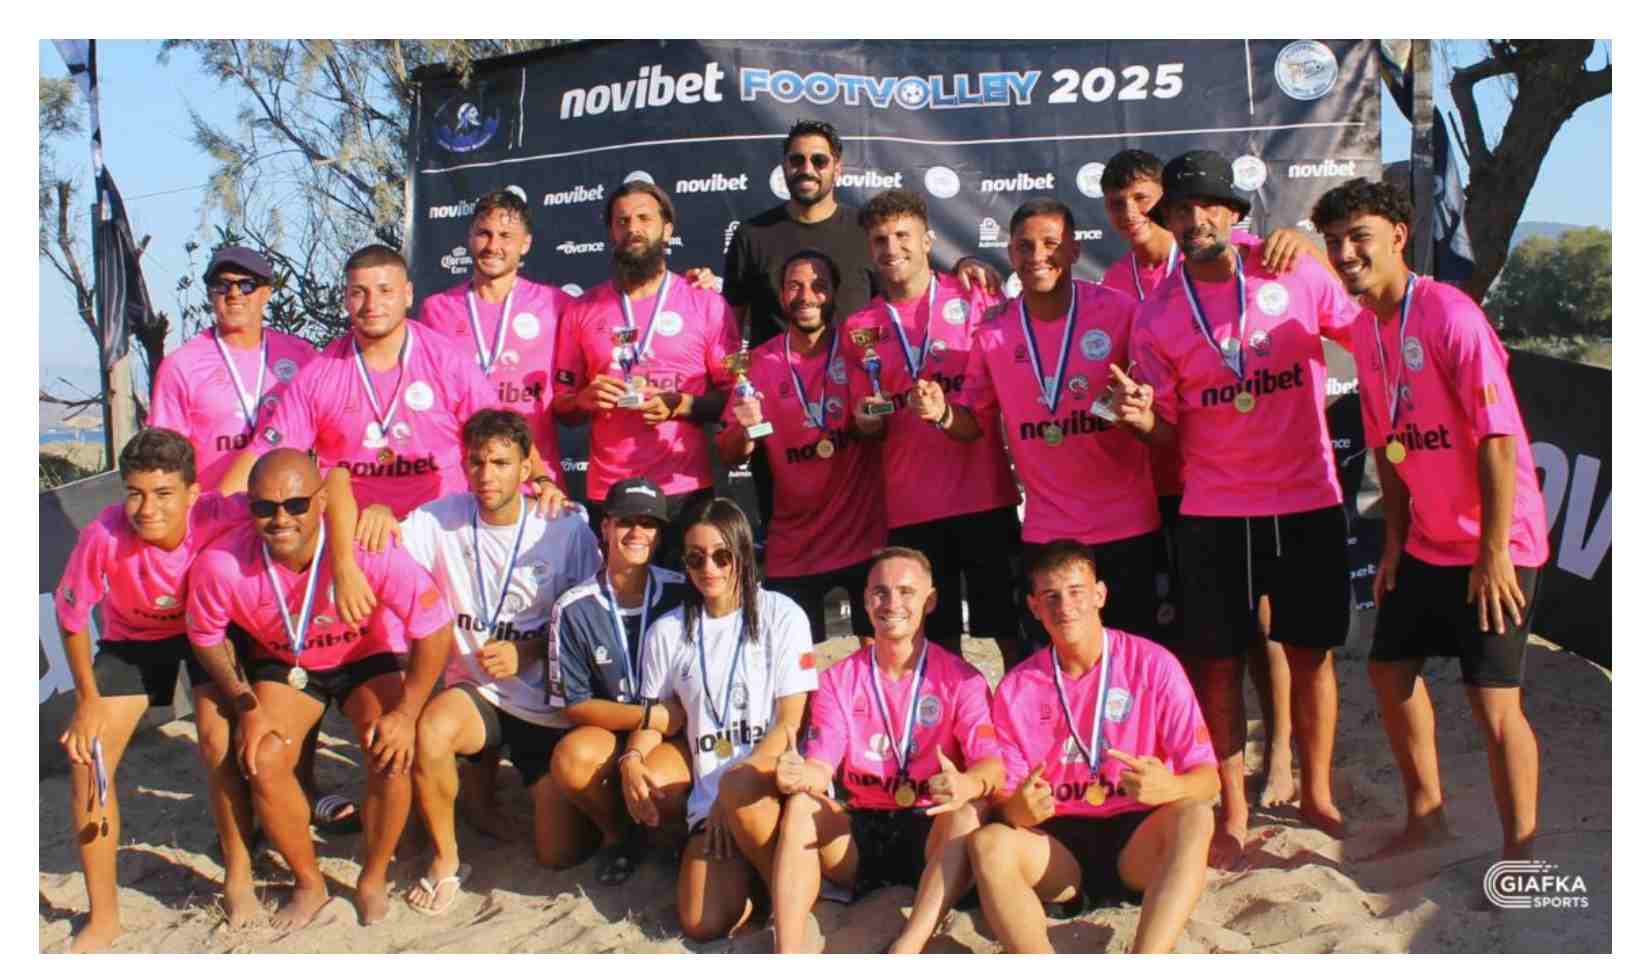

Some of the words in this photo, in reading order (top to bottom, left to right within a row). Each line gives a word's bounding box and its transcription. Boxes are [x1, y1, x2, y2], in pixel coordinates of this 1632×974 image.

[560, 62, 724, 120] novibet
[740, 67, 1040, 110] FOOTVOLLEY
[1048, 64, 1184, 104] 2025
[1288, 161, 1355, 179] novibet
[676, 173, 748, 193] novibet
[981, 173, 1055, 193] novibet
[544, 184, 605, 206] novibet
